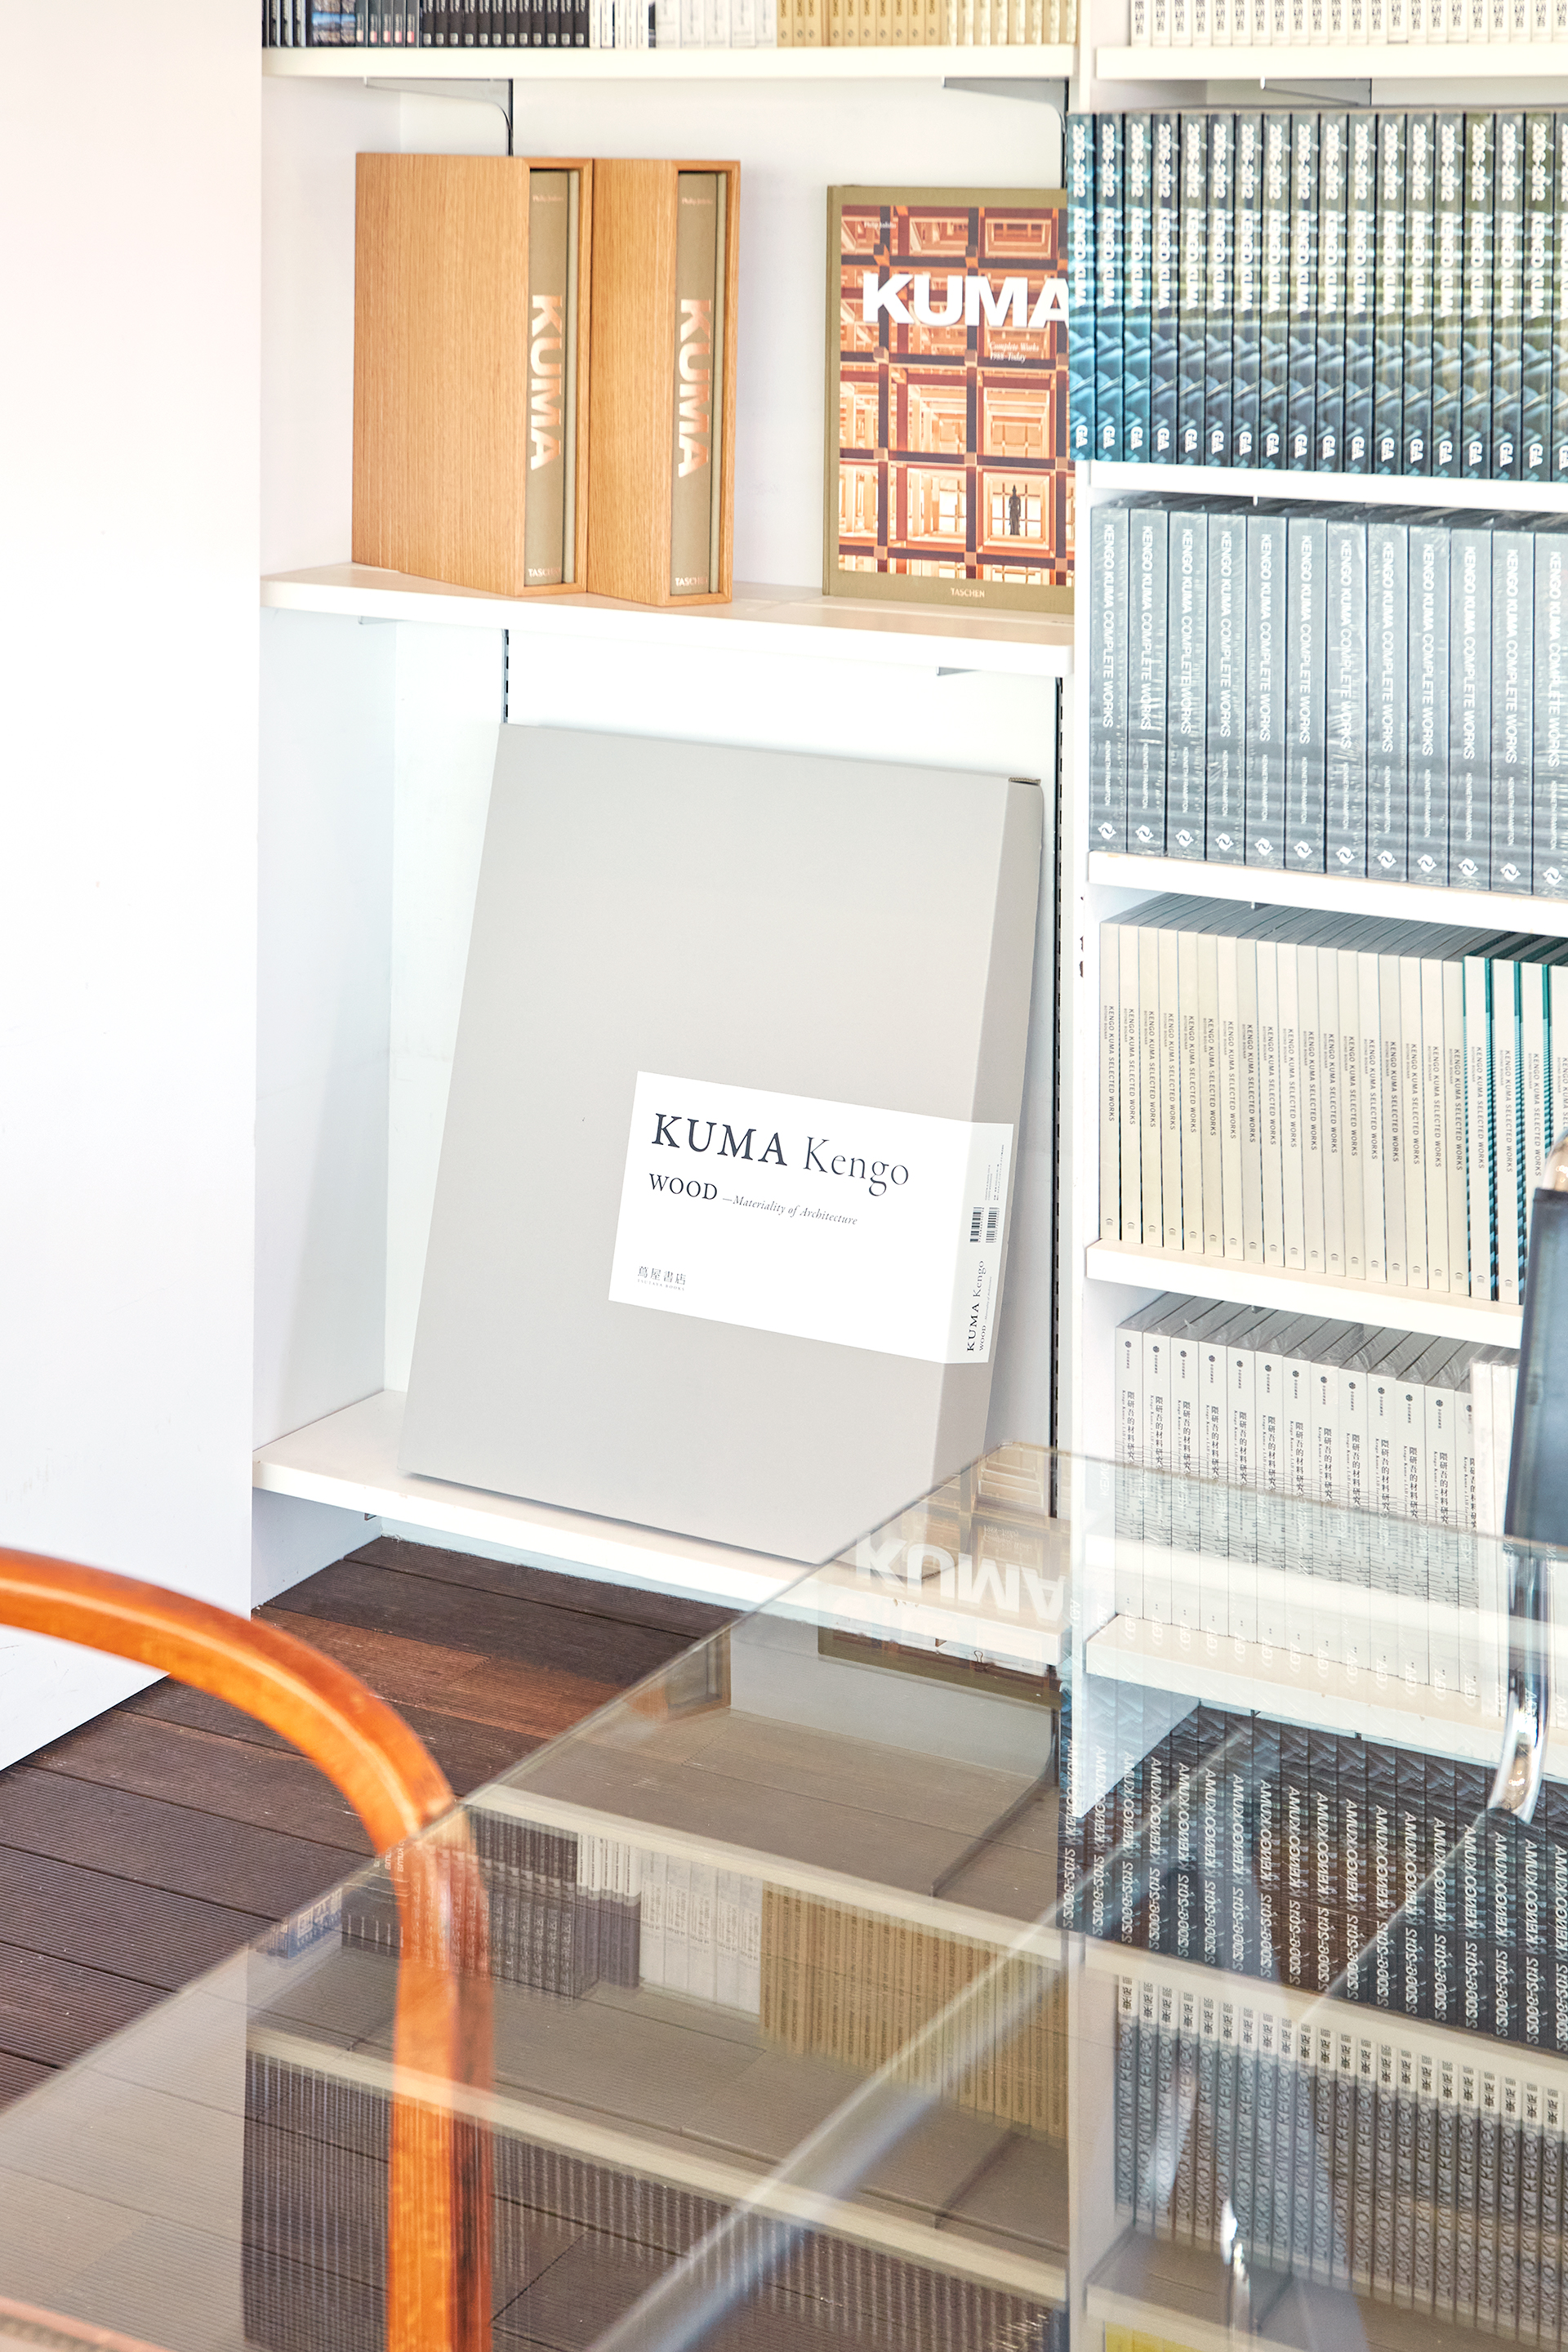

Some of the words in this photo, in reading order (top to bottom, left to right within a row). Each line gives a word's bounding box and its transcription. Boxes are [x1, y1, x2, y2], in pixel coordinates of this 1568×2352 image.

[1073, 123, 1085, 198] 2006-2012
[1132, 123, 1143, 198] 2006-2012
[1187, 124, 1200, 198] 2006-2012
[1241, 124, 1254, 199] 2006-2012
[1354, 124, 1369, 200] 2006-2012
[1412, 123, 1426, 201] 2006-2012
[1472, 122, 1486, 201] 2006-2012
[1532, 122, 1546, 201] 2006-2012
[1074, 207, 1086, 260] KENGO
[1131, 207, 1143, 261] KENGO
[1187, 208, 1199, 263] KENGO
[1241, 209, 1253, 264] KENGO
[1354, 211, 1367, 266] KENGO
[1411, 211, 1425, 268] KENGO
[1471, 212, 1485, 268] KENGO
[1530, 212, 1545, 269] KENGO
[862, 273, 1069, 328] KUMA
[1075, 262, 1086, 308] KUMA
[1131, 263, 1143, 309] KUMA
[1187, 265, 1199, 310] KUMA
[1241, 265, 1253, 312] KUMA
[1354, 268, 1365, 315] KUMA
[1411, 270, 1424, 317] KUMA
[1471, 270, 1483, 318] KUMA
[1530, 270, 1544, 319] KUMA
[990, 341, 1018, 352] Complete
[530, 295, 562, 470] KUMA
[678, 299, 711, 479] KUMA
[1076, 425, 1088, 448] GA
[1130, 426, 1143, 450] GA
[1185, 428, 1197, 452] GA
[1239, 431, 1252, 456] GA
[1351, 436, 1365, 461] GA
[1410, 439, 1423, 464] GA
[1468, 441, 1483, 466] GA
[1529, 443, 1544, 469] GA
[1104, 524, 1114, 570] KENGO
[1183, 529, 1192, 575] KENGO
[1221, 531, 1232, 577] KENGO
[1300, 536, 1312, 581] KENGO
[1383, 541, 1393, 588] KENGO
[1464, 546, 1476, 593] KENGO
[951, 587, 985, 598] TASCHEN
[1104, 571, 1114, 608] KUMA
[1183, 577, 1192, 614] KUMA
[1221, 579, 1232, 616] KUMA
[1550, 551, 1561, 599] KENGO
[1300, 584, 1312, 621] KUMA
[1383, 590, 1393, 629] KUMA
[1464, 595, 1475, 635] KUMA
[1550, 601, 1561, 641] KUMA
[1102, 611, 1114, 679] COMPLETE
[1181, 616, 1192, 686] COMPLETE
[1220, 618, 1232, 688] COMPLETE
[1300, 624, 1312, 693] COMPLETE
[1382, 631, 1393, 701] COMPLETE
[1463, 637, 1475, 707] COMPLETE
[1548, 643, 1561, 715] COMPLETE
[1102, 680, 1113, 728] WORKS
[1181, 686, 1192, 734] WORKS
[1220, 689, 1231, 737] WORKS
[1299, 696, 1310, 744] WORKS
[1382, 704, 1393, 753] WORKS
[1463, 710, 1475, 760] WORKS
[1548, 718, 1560, 767] WORKS
[652, 1113, 787, 1166] KUMA
[804, 1136, 909, 1196] Kengo
[648, 1173, 717, 1200] WOOD
[788, 1205, 799, 1218] of
[800, 1207, 858, 1225] Architecture
[973, 1261, 987, 1297] Kengo
[967, 1303, 980, 1352] KUMA
